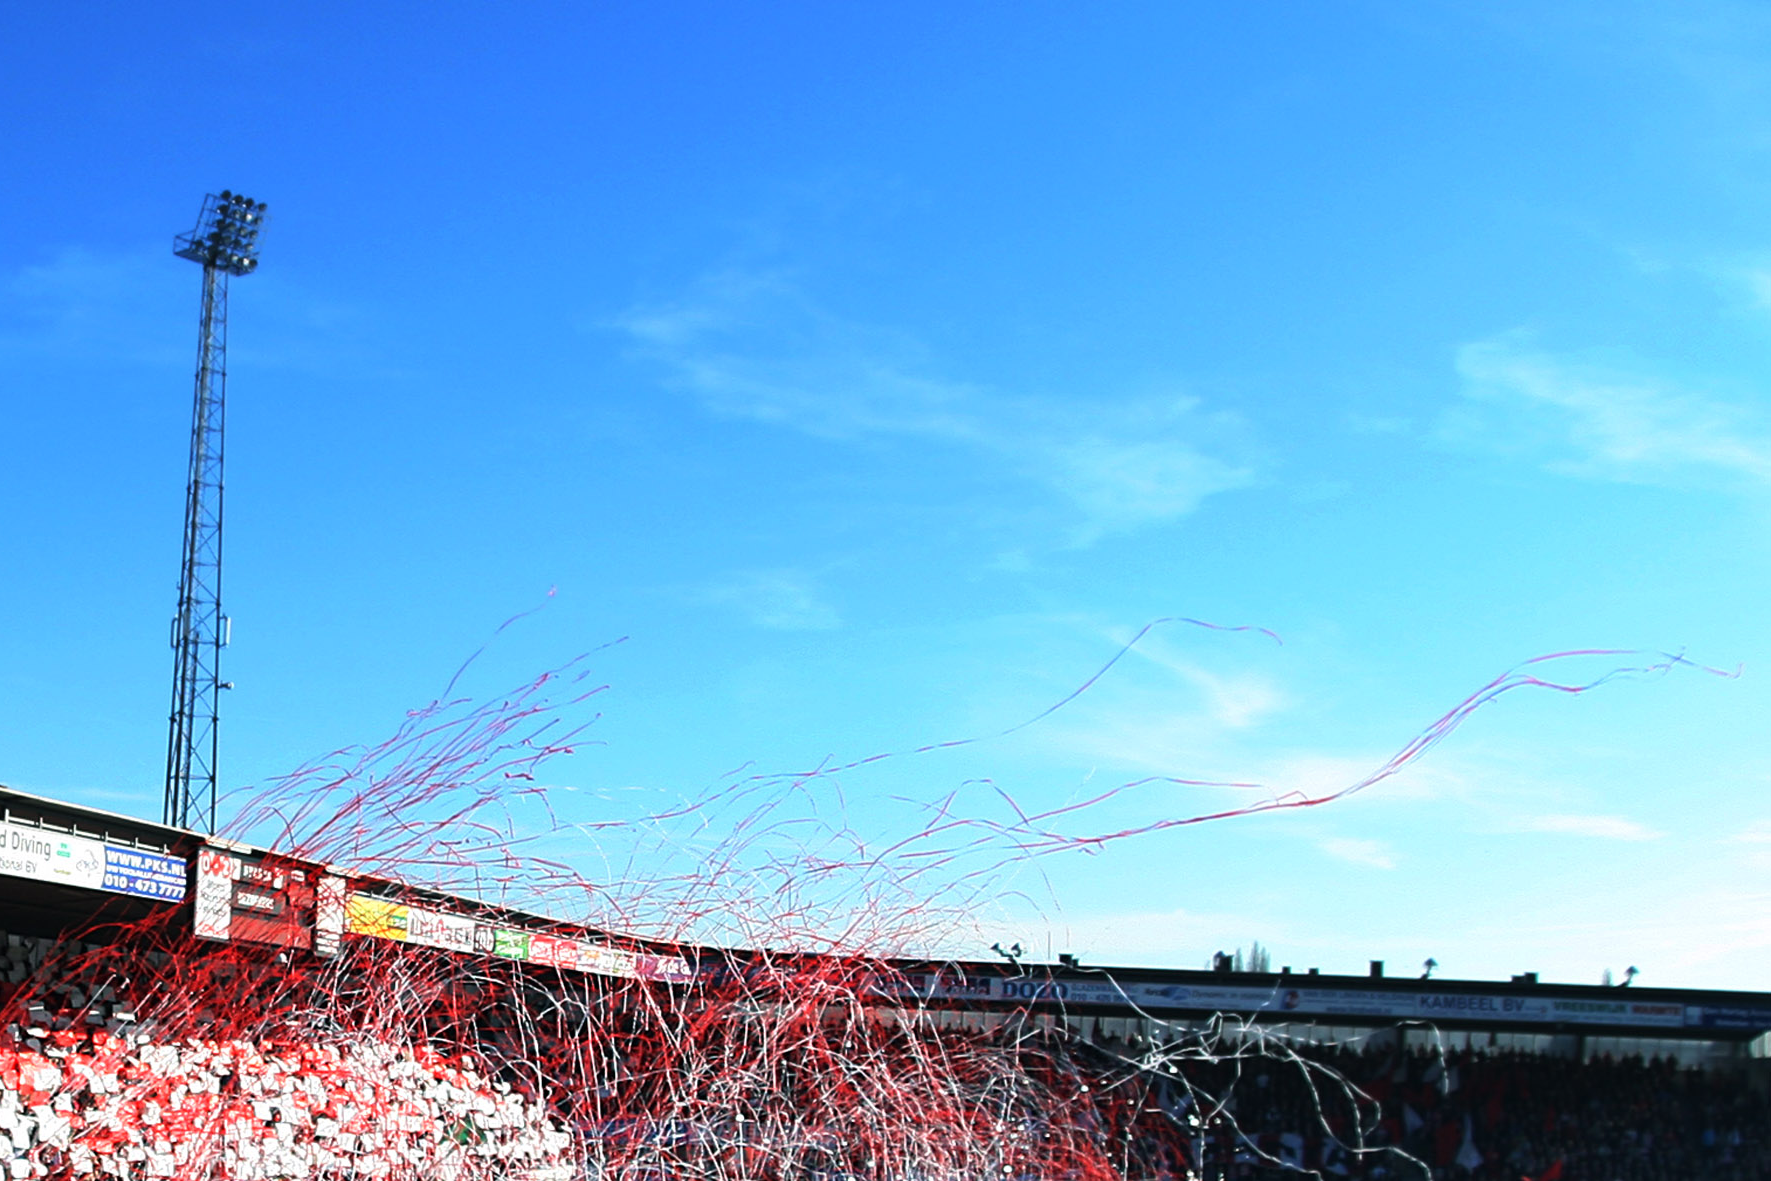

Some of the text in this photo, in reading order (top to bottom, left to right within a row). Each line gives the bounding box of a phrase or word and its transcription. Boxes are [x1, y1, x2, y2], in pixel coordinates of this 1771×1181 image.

[11, 831, 52, 861] Diving
[106, 850, 187, 878] WWW.PKS.NL
[104, 873, 128, 889] 010
[134, 879, 158, 894] 473
[158, 883, 186, 899] 7777
[1002, 982, 1069, 999] DOZO
[1420, 995, 1500, 1013] KAMBEEL
